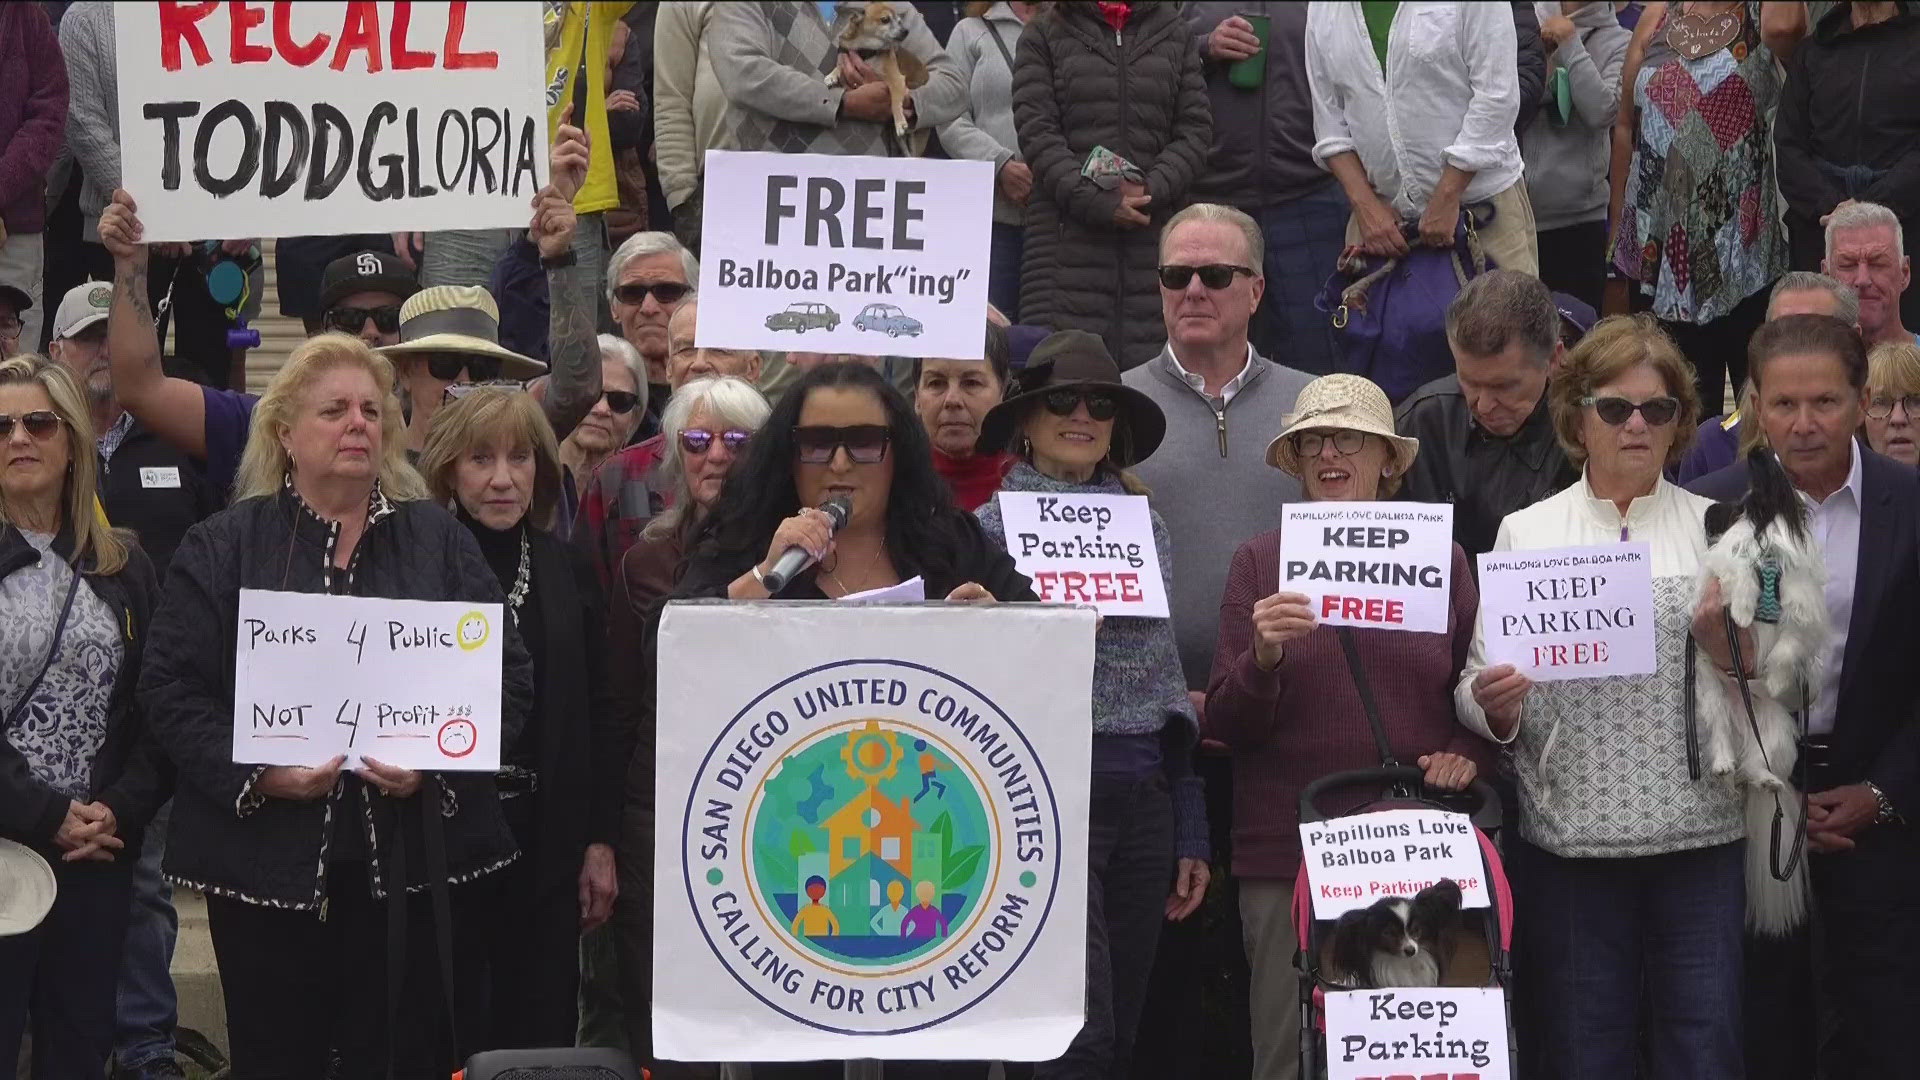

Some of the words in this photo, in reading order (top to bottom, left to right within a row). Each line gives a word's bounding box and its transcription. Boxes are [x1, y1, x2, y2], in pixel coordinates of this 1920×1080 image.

[159, 1, 498, 73] RECALL
[764, 175, 926, 251] FREE
[718, 259, 818, 290] Balboa
[1037, 497, 1111, 531] Keep
[1290, 511, 1344, 521] PAPILLONS
[1346, 511, 1372, 520] LOVE
[1374, 511, 1415, 521] BALBOA
[1417, 513, 1444, 522] PARK
[1018, 533, 1144, 568] Parking
[1323, 526, 1409, 549] KEEP
[1287, 561, 1443, 589] PARKING
[1486, 560, 1541, 572] PAPILLONS
[1544, 557, 1570, 568] LOVE
[1572, 555, 1613, 566] BALBOA
[1615, 552, 1641, 563] PARK
[1035, 571, 1143, 602] FREE
[1525, 575, 1606, 602] KEEP
[1321, 595, 1404, 624] FREE
[1501, 607, 1636, 636] PARKING
[244, 618, 317, 650] Parks
[347, 620, 367, 665] 4
[386, 620, 453, 651] Public
[1532, 641, 1609, 667] FREE
[793, 679, 907, 720] UNITED
[253, 702, 313, 729] NOT
[336, 698, 361, 748] 4
[375, 703, 440, 729] Profit
[716, 710, 790, 792] DIEGO
[918, 688, 1043, 863] COMMUNITIES
[701, 799, 733, 860] SAN
[1309, 822, 1410, 846] Papillons
[1418, 819, 1468, 835] Love
[1321, 849, 1395, 868] Balboa
[1404, 842, 1453, 861] Park
[1321, 883, 1363, 899] Keep
[711, 890, 804, 994] CALLING
[809, 979, 865, 1014] FOR
[877, 975, 937, 1014] CITY
[943, 892, 1029, 990] REFORM
[1369, 993, 1458, 1027] Keep
[1341, 1031, 1490, 1068] Parking
